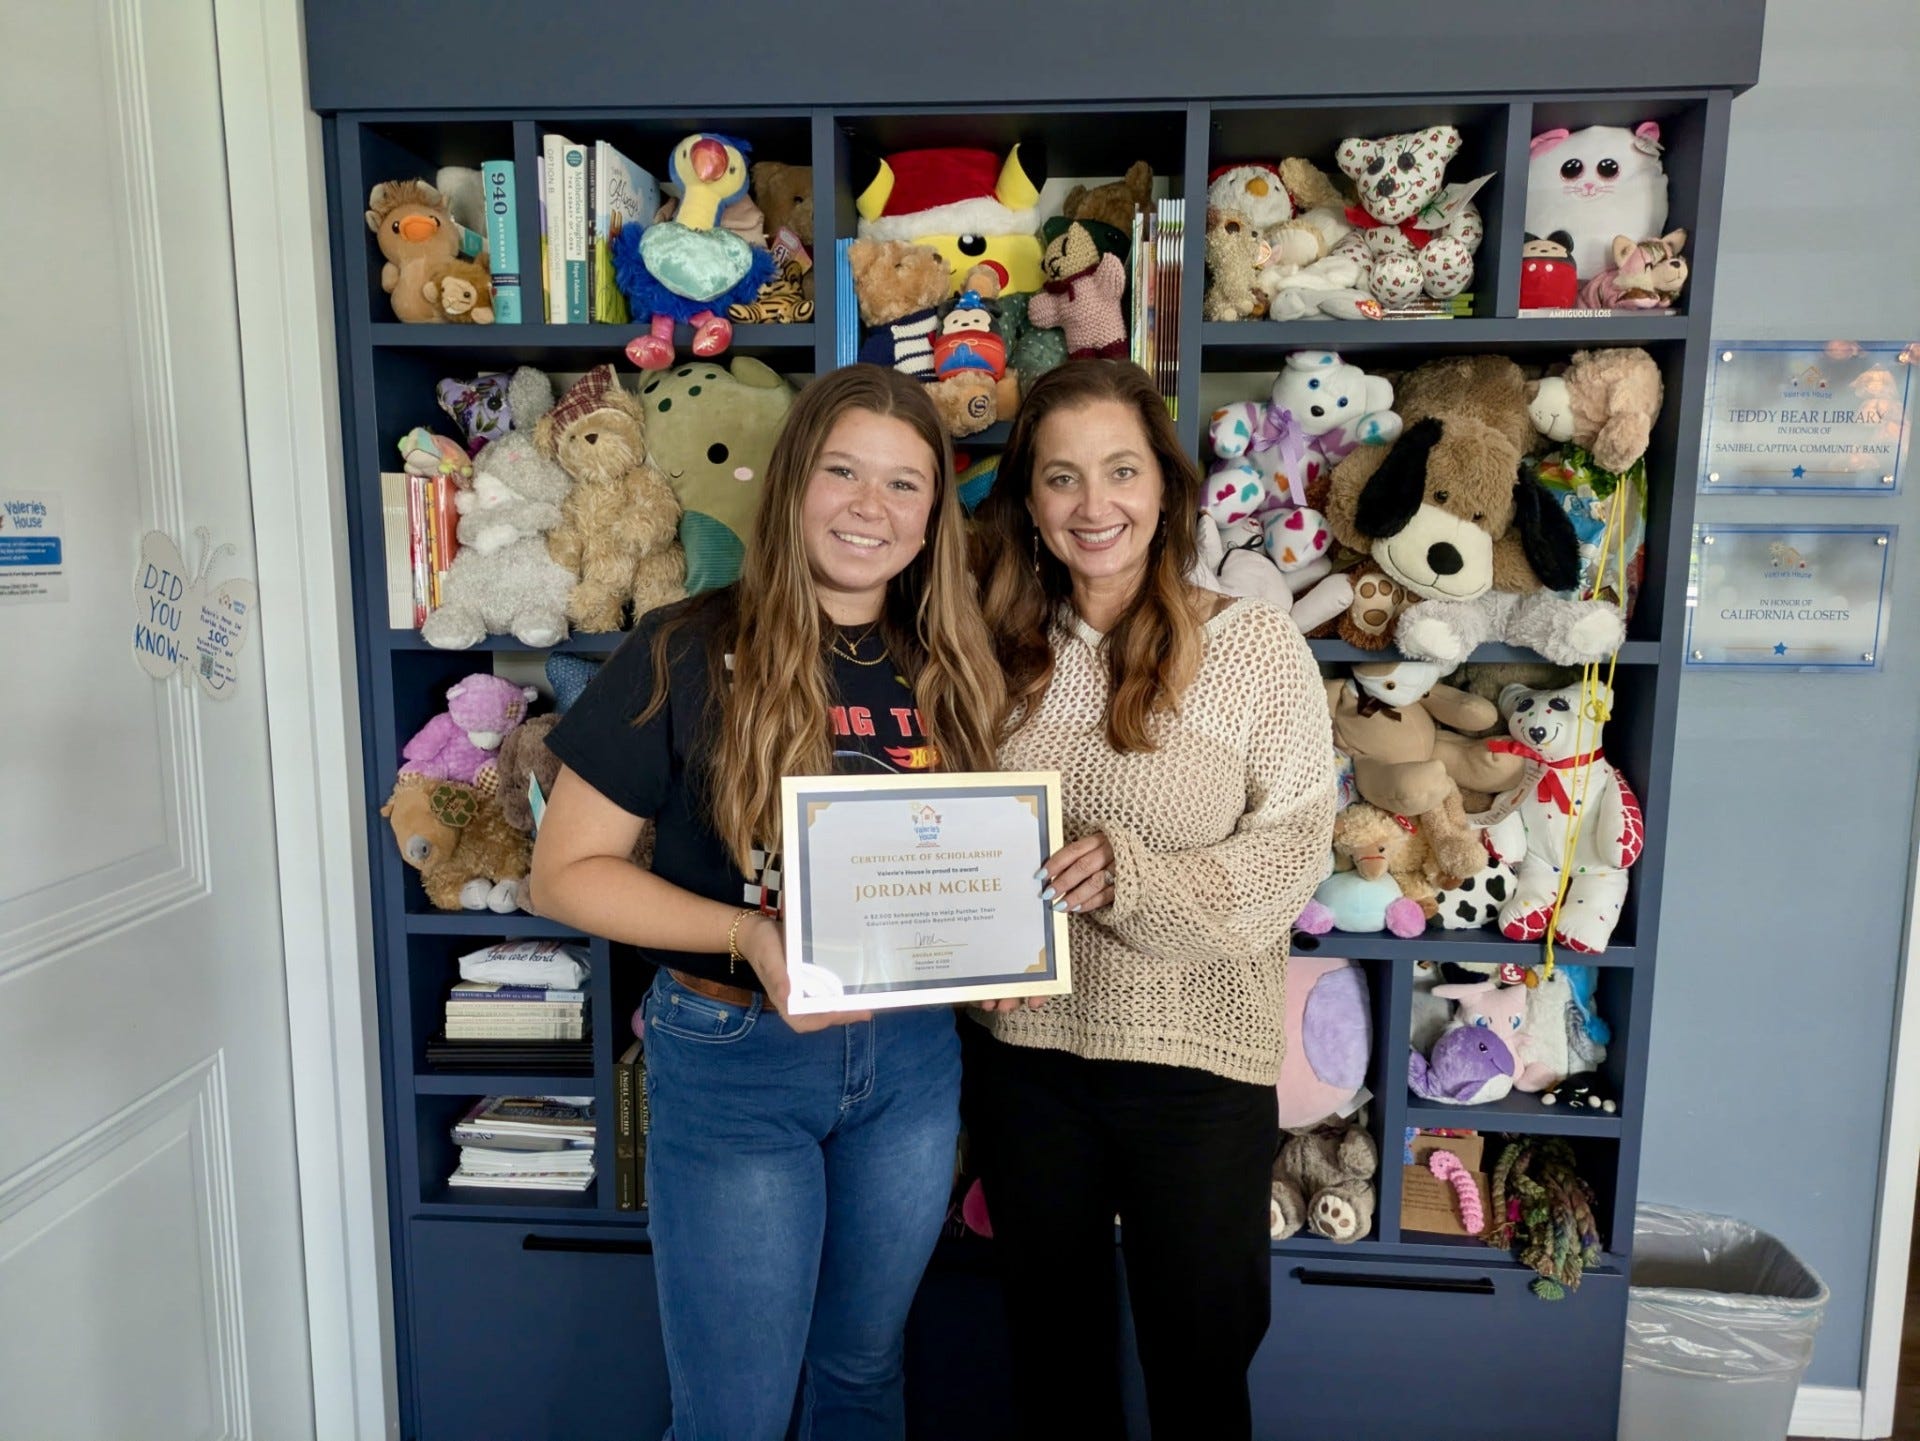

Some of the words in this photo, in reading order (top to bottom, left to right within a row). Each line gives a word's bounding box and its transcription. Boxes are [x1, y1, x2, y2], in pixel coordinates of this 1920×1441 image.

[491, 172, 508, 215] 940
[574, 171, 583, 214] Motherless
[573, 216, 584, 256] Daughters
[572, 262, 580, 278] Hope
[1550, 309, 1593, 318] AMBIGUOUS
[1595, 309, 1612, 318] LOSS
[1729, 410, 1778, 424] TEDDY
[1780, 410, 1819, 424] BEAR
[1822, 410, 1886, 425] LIBRARY
[1777, 427, 1788, 435] IN
[1788, 427, 1819, 435] HONOR
[1820, 427, 1832, 435] OF
[1715, 443, 1755, 453] SANIBEL
[1757, 444, 1798, 454] CAPTIVA
[1800, 445, 1861, 454] COMMUNITY
[1862, 445, 1891, 454] BANK
[4, 501, 47, 516] Valerie's
[13, 516, 43, 529] House
[144, 564, 183, 601] DID
[149, 595, 182, 632] YOU
[1720, 609, 1795, 620] CALIFORNIA
[1797, 609, 1850, 621] CLOSETS
[208, 629, 229, 648] 100
[850, 854, 917, 865] CERTIFICATE
[919, 853, 932, 861] OF
[935, 850, 1003, 860] SCHOLARSHIP
[932, 867, 951, 875] proud
[854, 881, 932, 903] JORDAN
[938, 877, 1003, 895] MCKEE
[485, 951, 506, 963] You
[508, 953, 528, 962] are
[529, 951, 560, 963] kind
[623, 1099, 631, 1136] CATCHER
